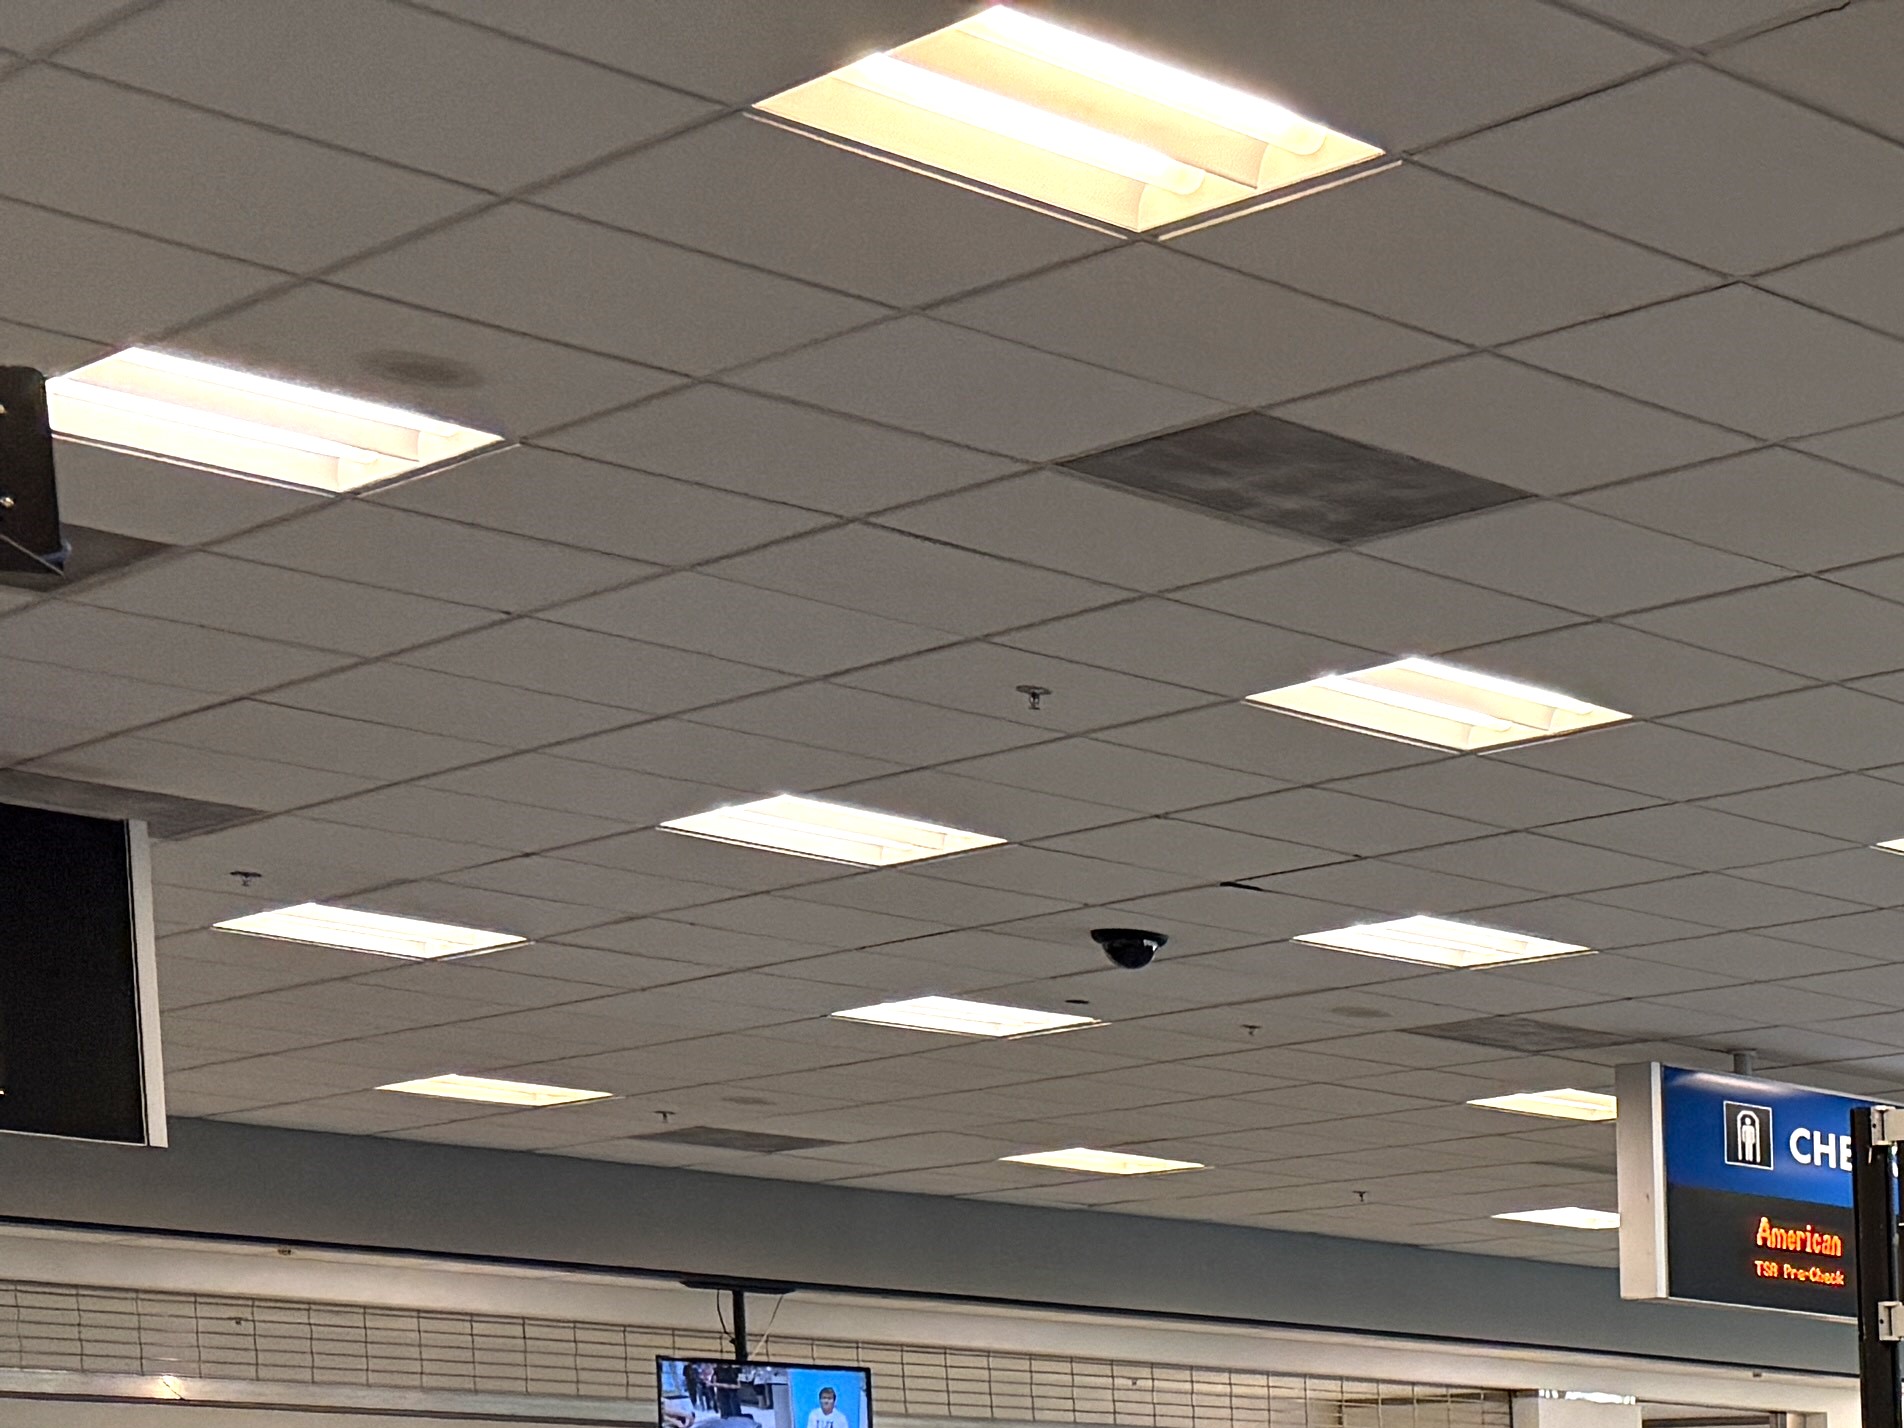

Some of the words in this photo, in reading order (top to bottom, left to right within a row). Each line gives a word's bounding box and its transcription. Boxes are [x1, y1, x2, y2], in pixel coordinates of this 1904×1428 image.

[1757, 1216, 1842, 1257] American
[1754, 1260, 1778, 1278] TSA
[1784, 1264, 1844, 1286] Pre-Check
